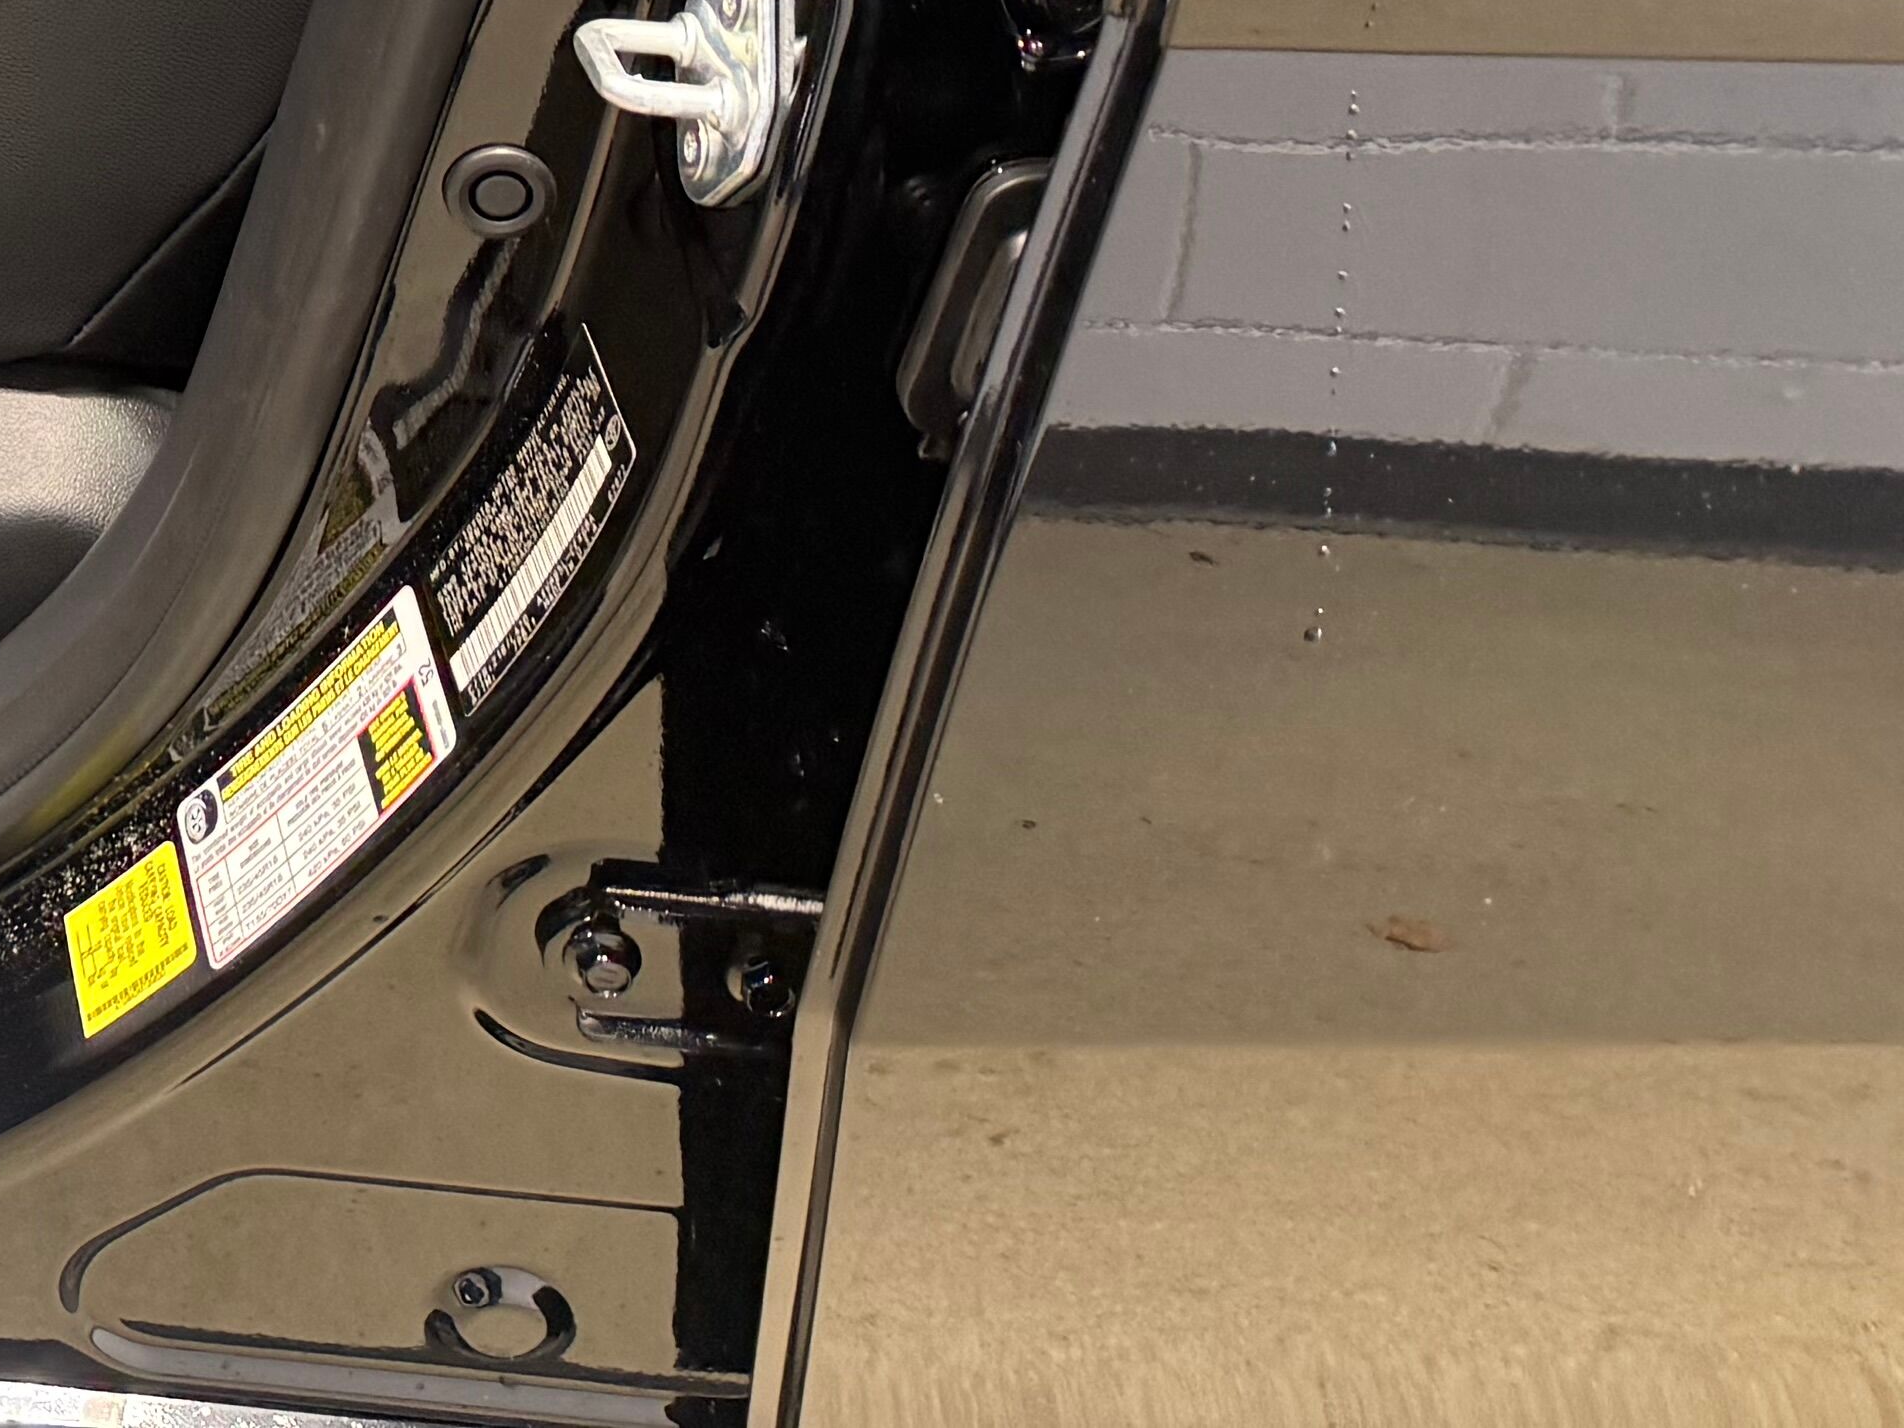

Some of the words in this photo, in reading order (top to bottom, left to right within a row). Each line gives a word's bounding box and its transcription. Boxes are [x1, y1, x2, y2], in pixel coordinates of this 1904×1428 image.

[253, 727, 276, 758] AND
[275, 685, 320, 737] LOADING
[319, 619, 384, 695] INFORMATION
[417, 656, 435, 687] 52
